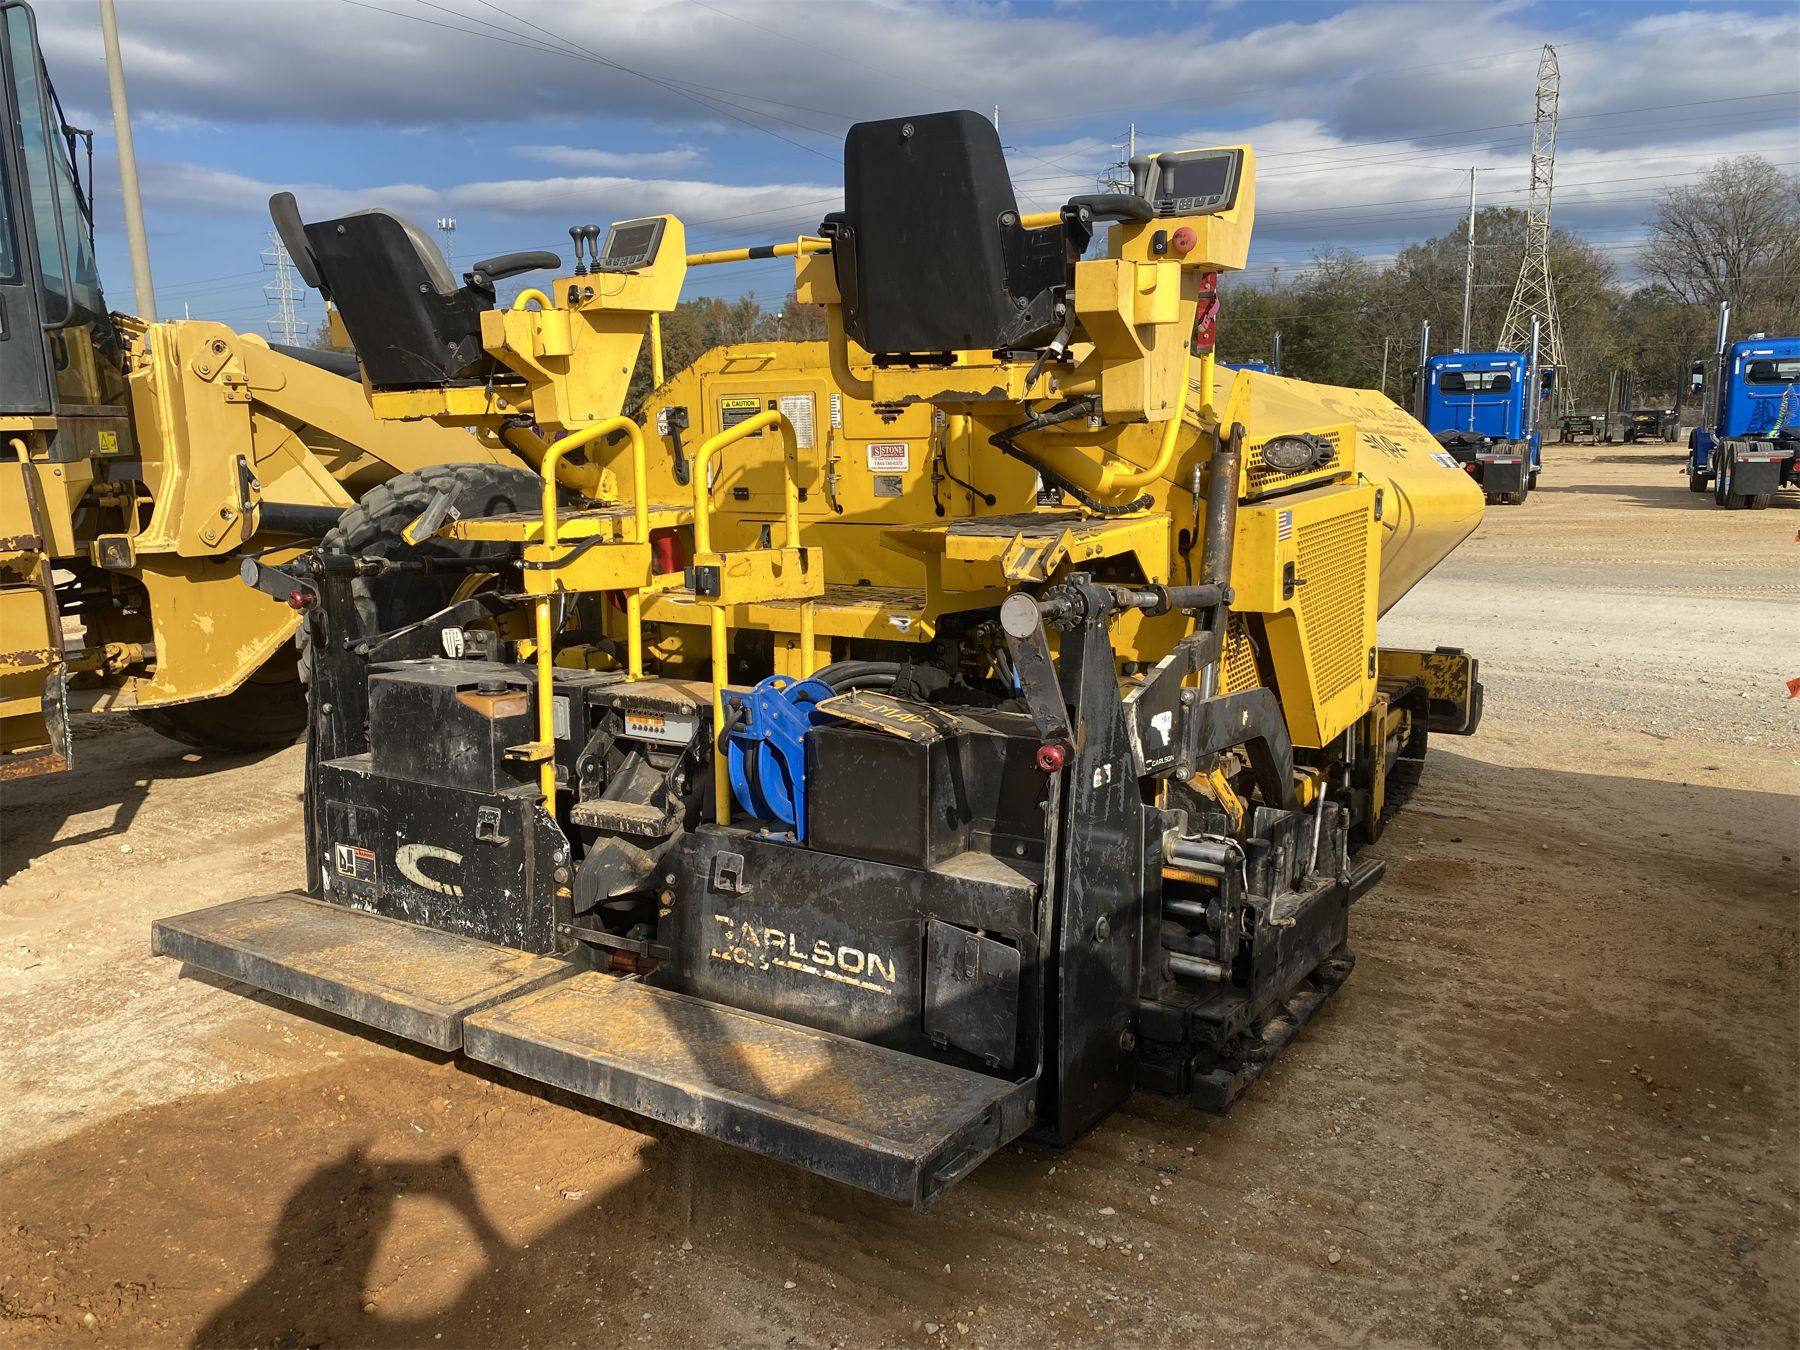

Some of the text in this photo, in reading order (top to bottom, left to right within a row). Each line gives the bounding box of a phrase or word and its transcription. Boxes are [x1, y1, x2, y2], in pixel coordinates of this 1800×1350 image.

[881, 446, 904, 454] STONE
[869, 704, 926, 723] MAP
[1151, 754, 1175, 767] CARLSON
